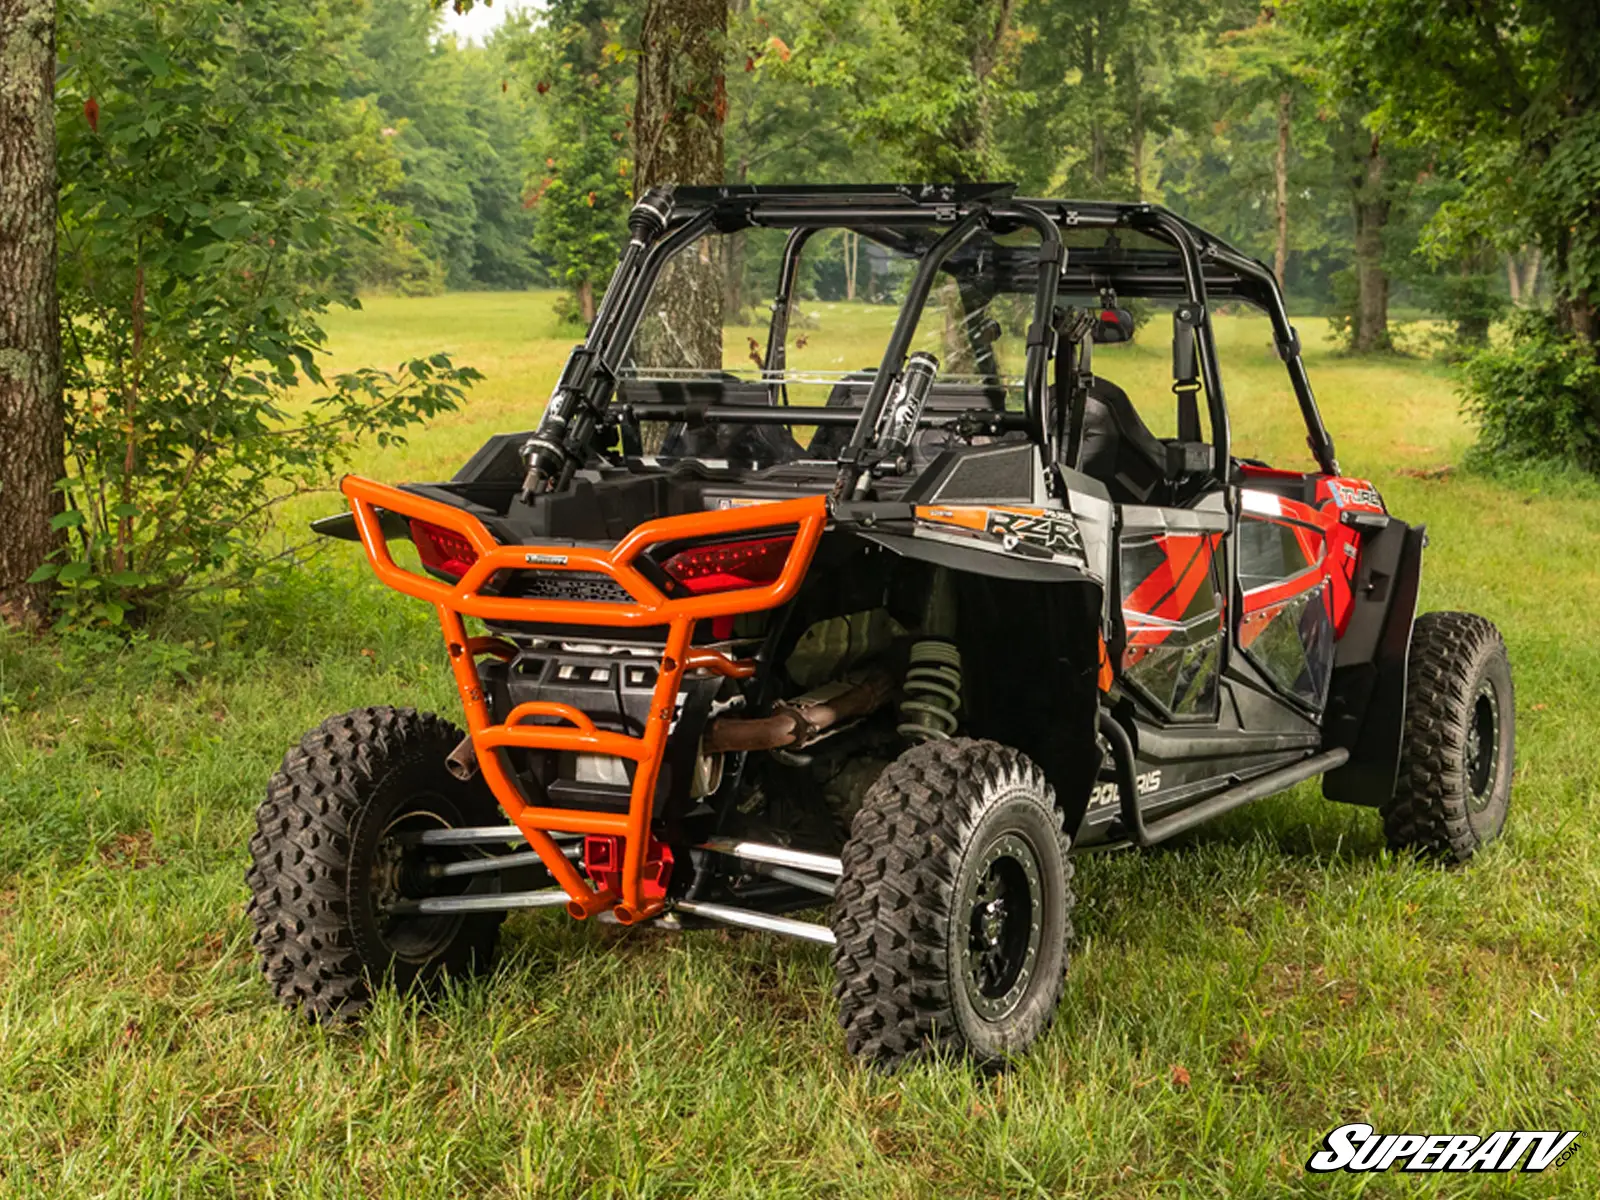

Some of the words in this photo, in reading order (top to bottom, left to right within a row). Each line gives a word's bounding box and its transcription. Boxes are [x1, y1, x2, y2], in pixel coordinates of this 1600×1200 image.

[1340, 486, 1382, 507] TURB
[989, 510, 1083, 550] RZR
[1087, 769, 1162, 809] POLRIS
